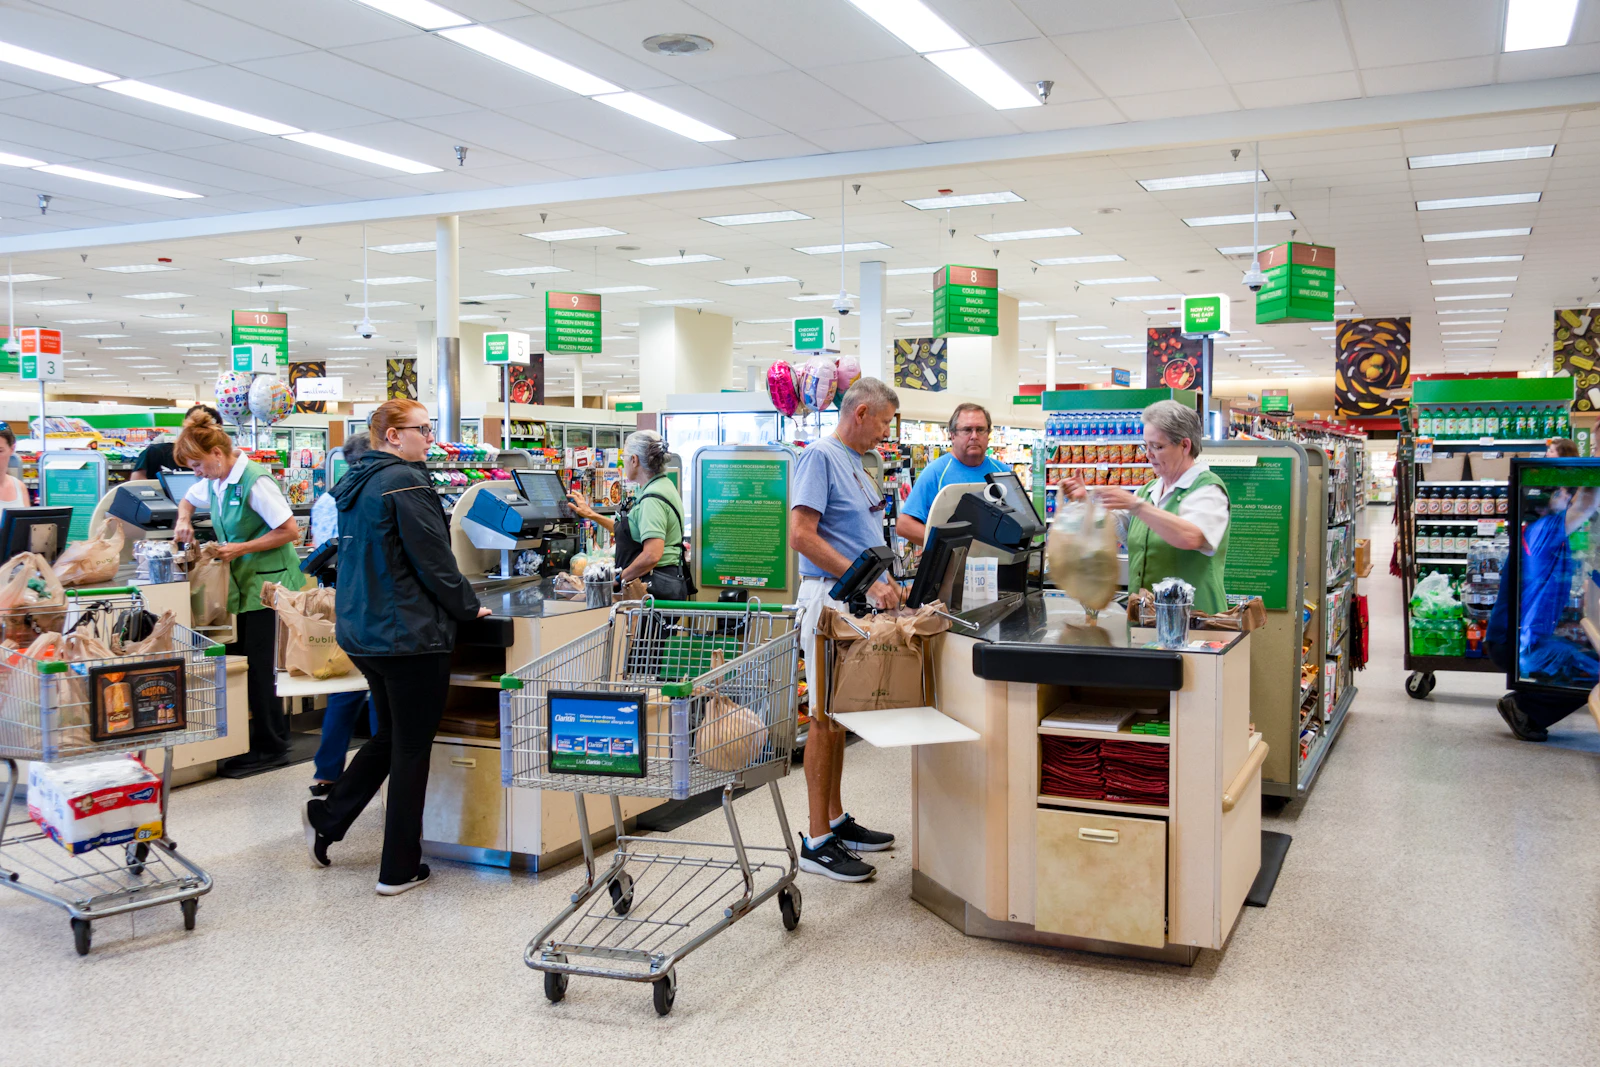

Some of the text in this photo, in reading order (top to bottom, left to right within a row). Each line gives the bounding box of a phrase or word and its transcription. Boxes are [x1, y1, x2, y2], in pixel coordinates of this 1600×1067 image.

[1268, 250, 1274, 265] 7
[1311, 248, 1317, 262] 7
[971, 270, 977, 283] 8
[1302, 268, 1326, 277] CHAMPAGNE
[1310, 290, 1328, 298] COOLERS
[572, 296, 579, 307] 9
[254, 314, 268, 324] 10
[830, 326, 835, 343] 6
[518, 341, 523, 356] 5
[261, 353, 268, 367] 4
[47, 361, 55, 374] 3
[975, 577, 985, 586] $10
[872, 644, 898, 652] Publx
[110, 713, 129, 721] Crafted
[138, 830, 152, 839] 48
